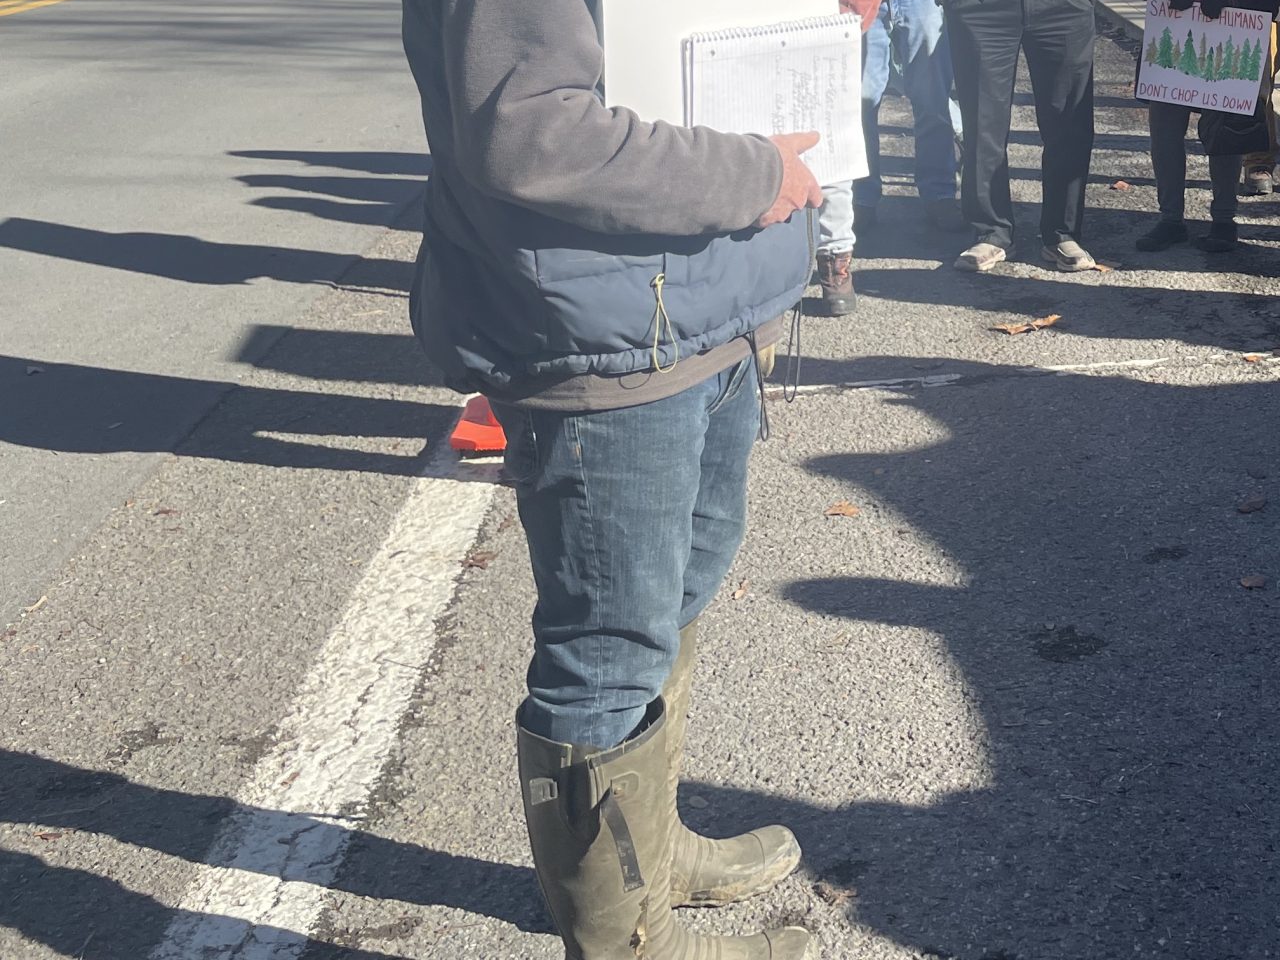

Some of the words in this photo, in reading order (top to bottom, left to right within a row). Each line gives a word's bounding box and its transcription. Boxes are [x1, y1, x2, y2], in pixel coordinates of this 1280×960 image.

[1219, 10, 1264, 31] HUMANS
[1139, 82, 1168, 99] DON'T
[1170, 87, 1199, 103] CHOP
[1202, 92, 1218, 107] US
[1222, 95, 1252, 111] DOWN
